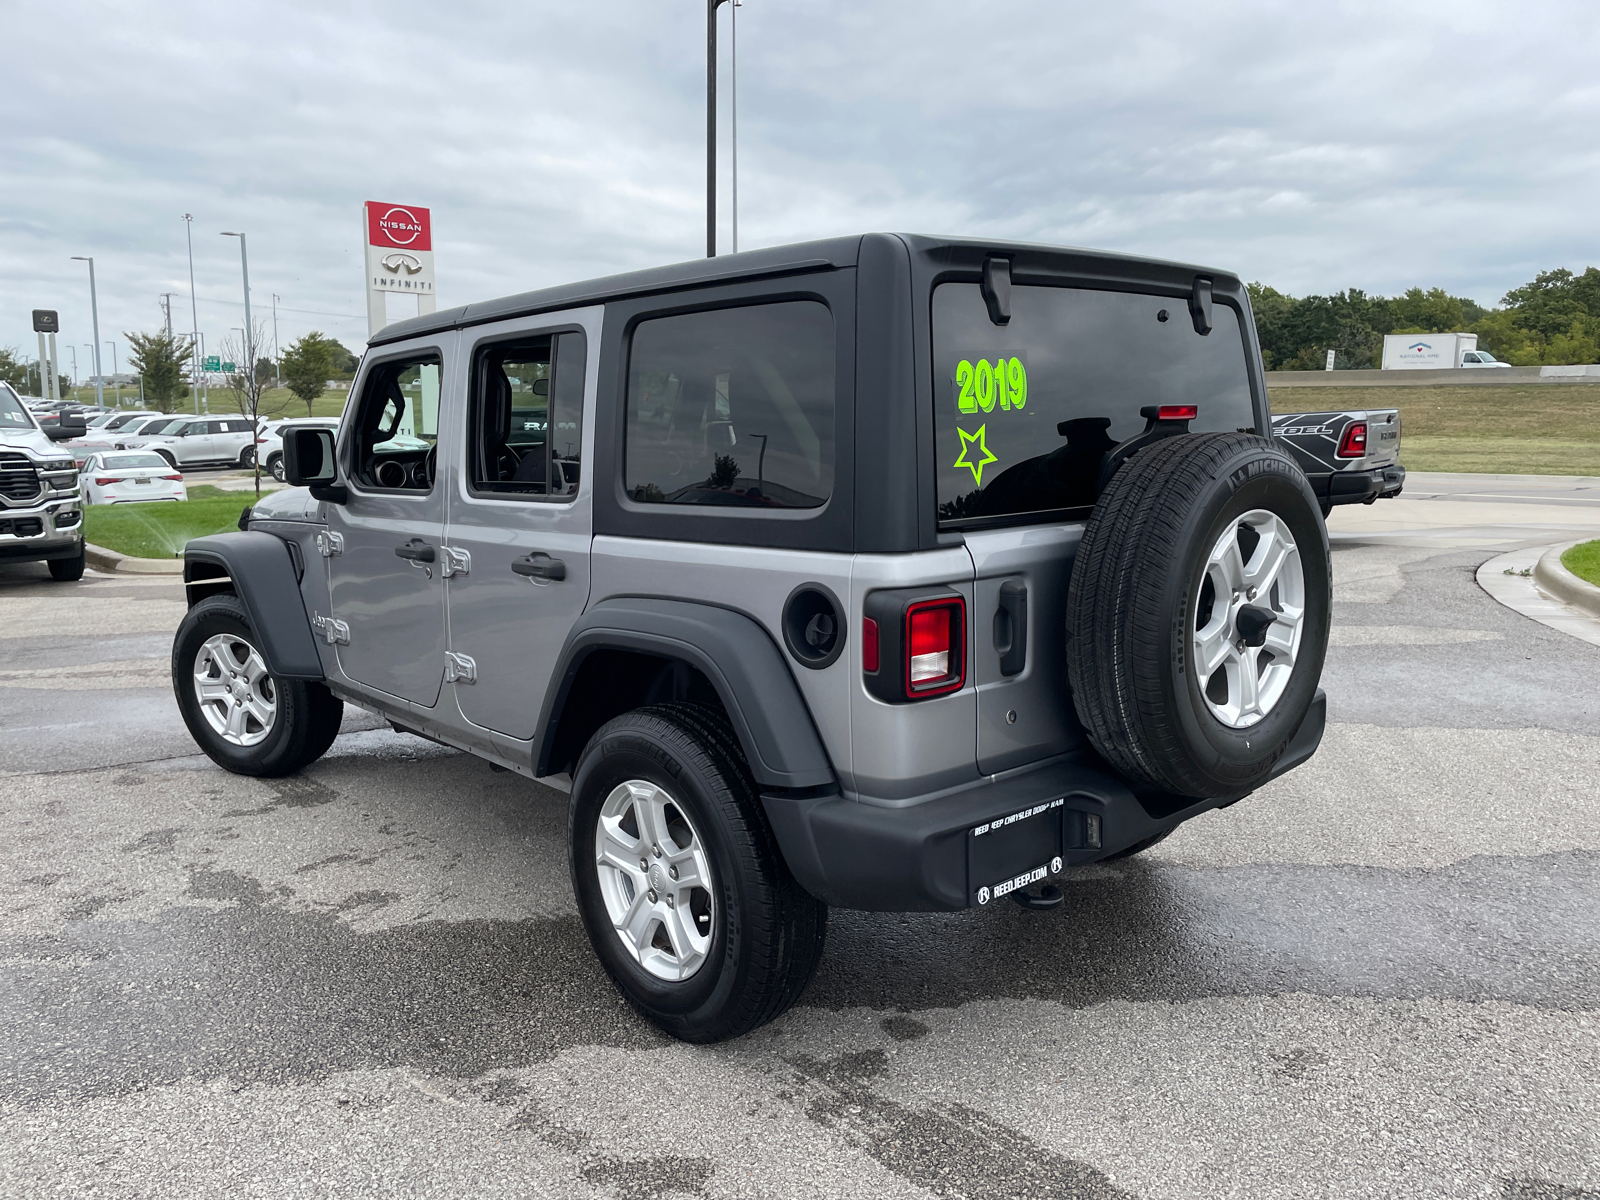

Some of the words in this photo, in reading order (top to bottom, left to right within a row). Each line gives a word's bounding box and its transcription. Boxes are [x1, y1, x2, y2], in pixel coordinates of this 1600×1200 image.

[380, 220, 421, 232] NISSAN
[374, 277, 432, 290] INFINITI
[956, 356, 1028, 414] 2019
[1272, 425, 1334, 437] EBEL
[1247, 459, 1302, 481] MICHELIN
[312, 610, 326, 628] Jee
[974, 824, 989, 836] REED
[1004, 809, 1033, 825] CHRYSLER
[993, 866, 1047, 898] REEDJEEP.COM
